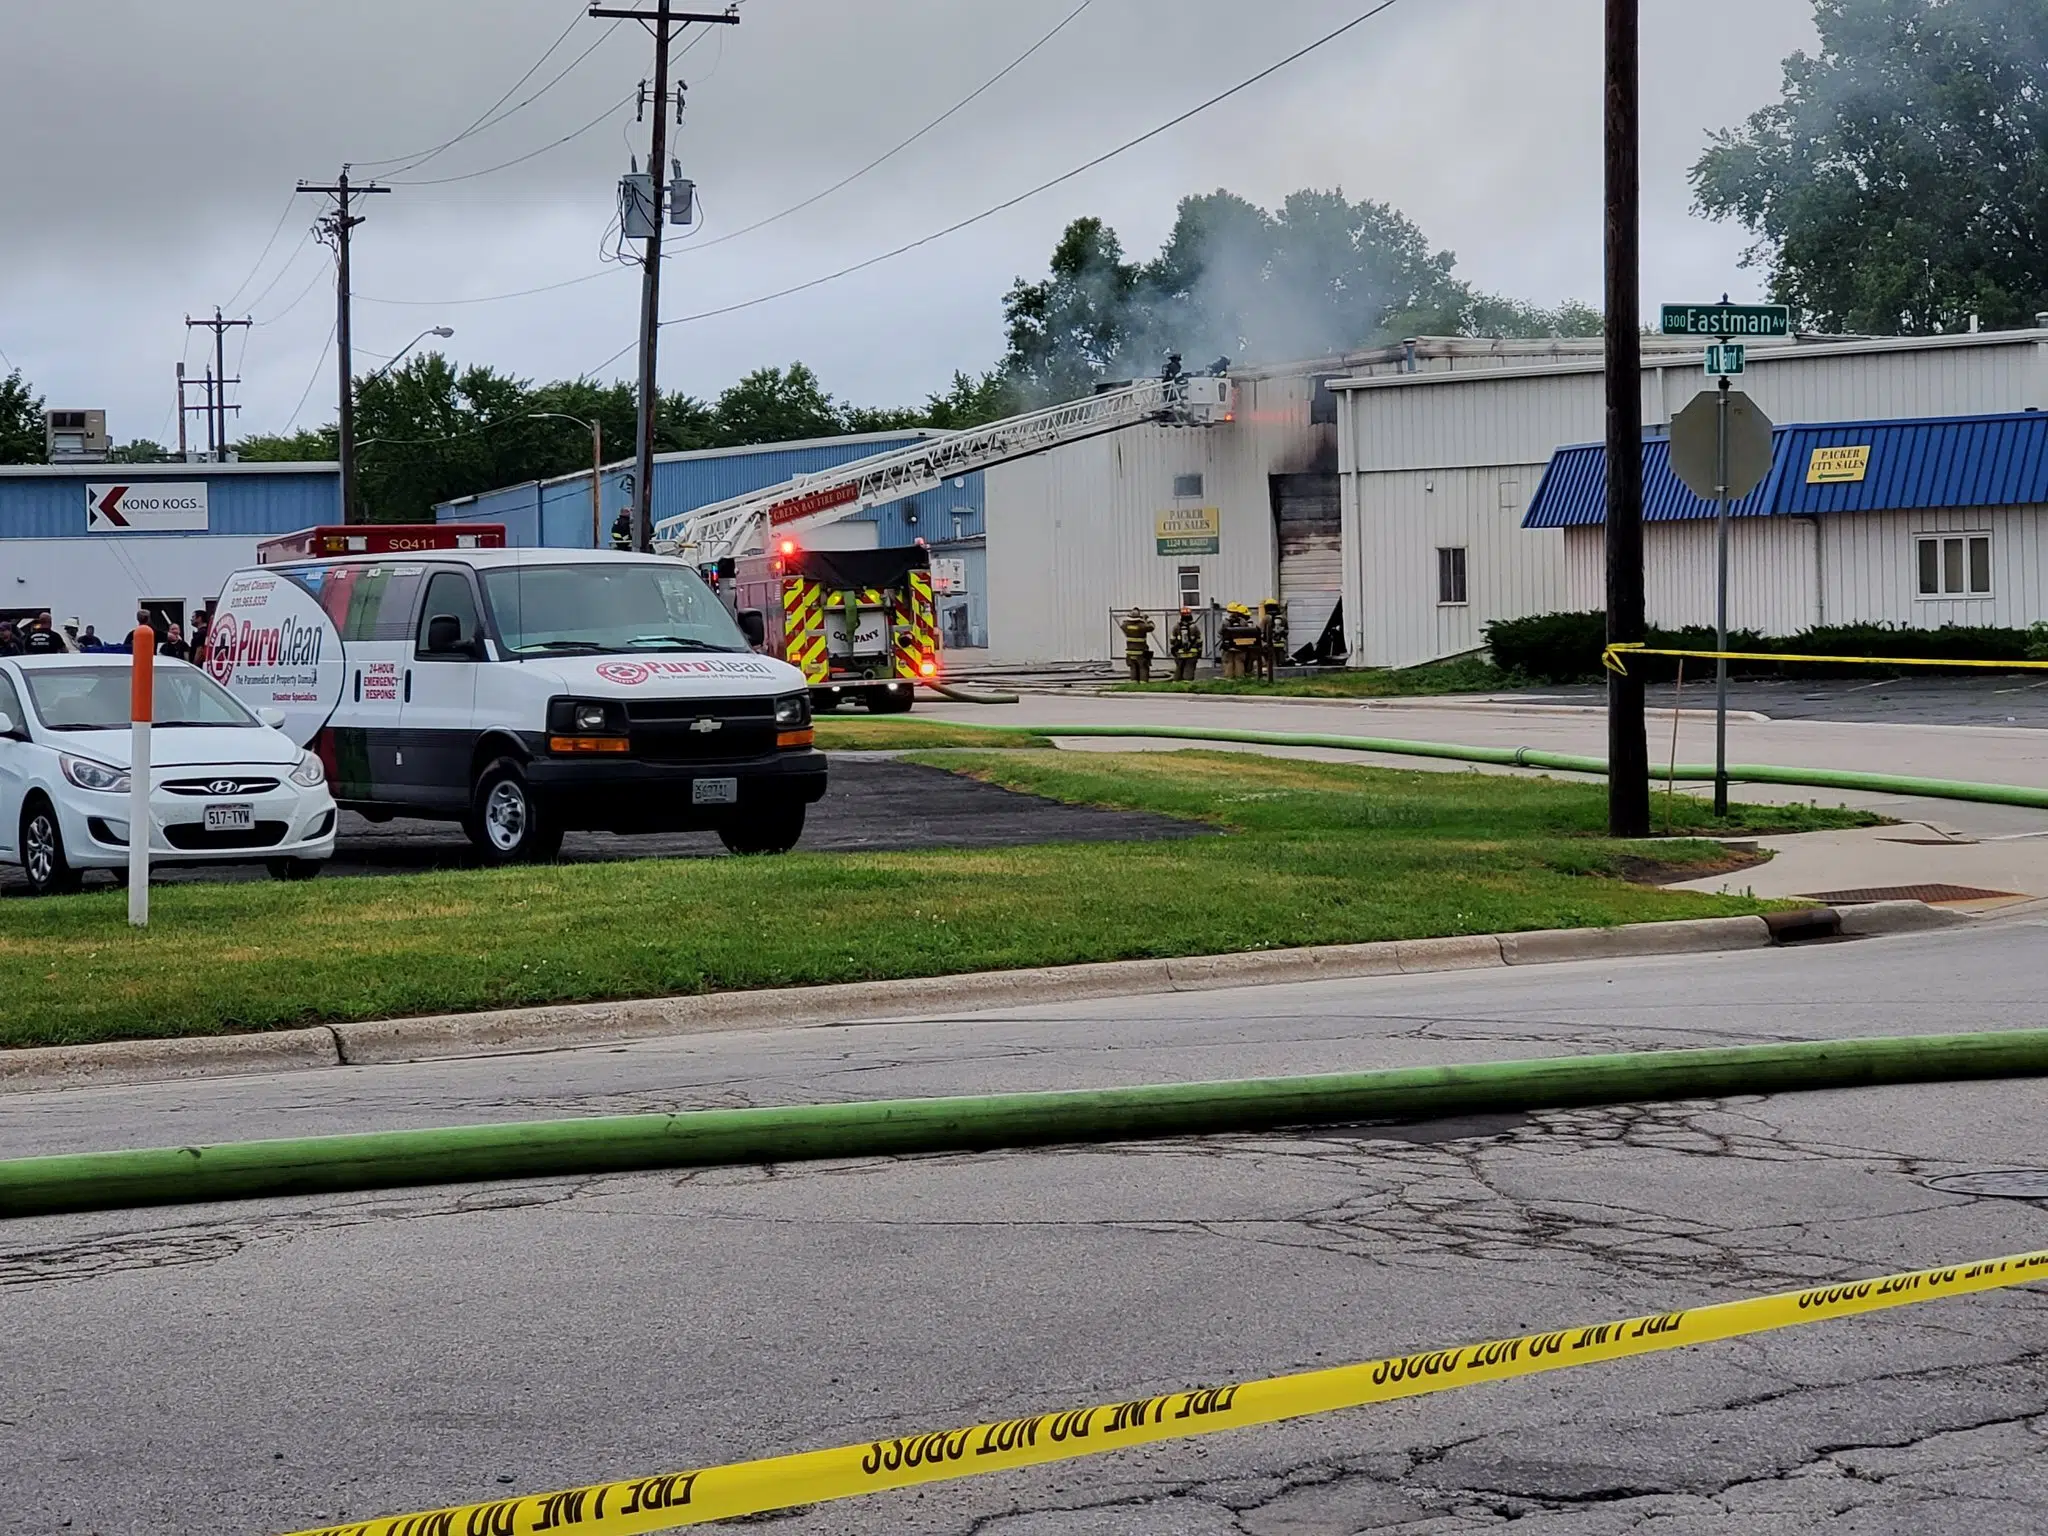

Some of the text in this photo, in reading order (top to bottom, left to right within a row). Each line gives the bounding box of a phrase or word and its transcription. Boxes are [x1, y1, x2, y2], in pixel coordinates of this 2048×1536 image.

[1664, 309, 1785, 333] 1300 Eastman Av
[1821, 449, 1860, 460] PACKER
[1811, 459, 1865, 470] CITY SALES
[122, 498, 197, 510] KONO KOGS
[773, 505, 800, 520] GREEN
[801, 501, 815, 512] BAY
[816, 494, 834, 507] FIRE
[1163, 519, 1210, 531] CITY SALES
[388, 539, 436, 550] SQ411
[236, 614, 323, 667] PuroClean
[833, 629, 879, 643] COPANY
[643, 660, 772, 674] PuroClean
[235, 674, 243, 685] The
[276, 674, 297, 687] Property
[364, 676, 398, 687] EMERGENCY
[365, 689, 396, 700] RESPONSE
[976, 1417, 1045, 1456] NOT
[862, 1428, 974, 1474] CROSS
